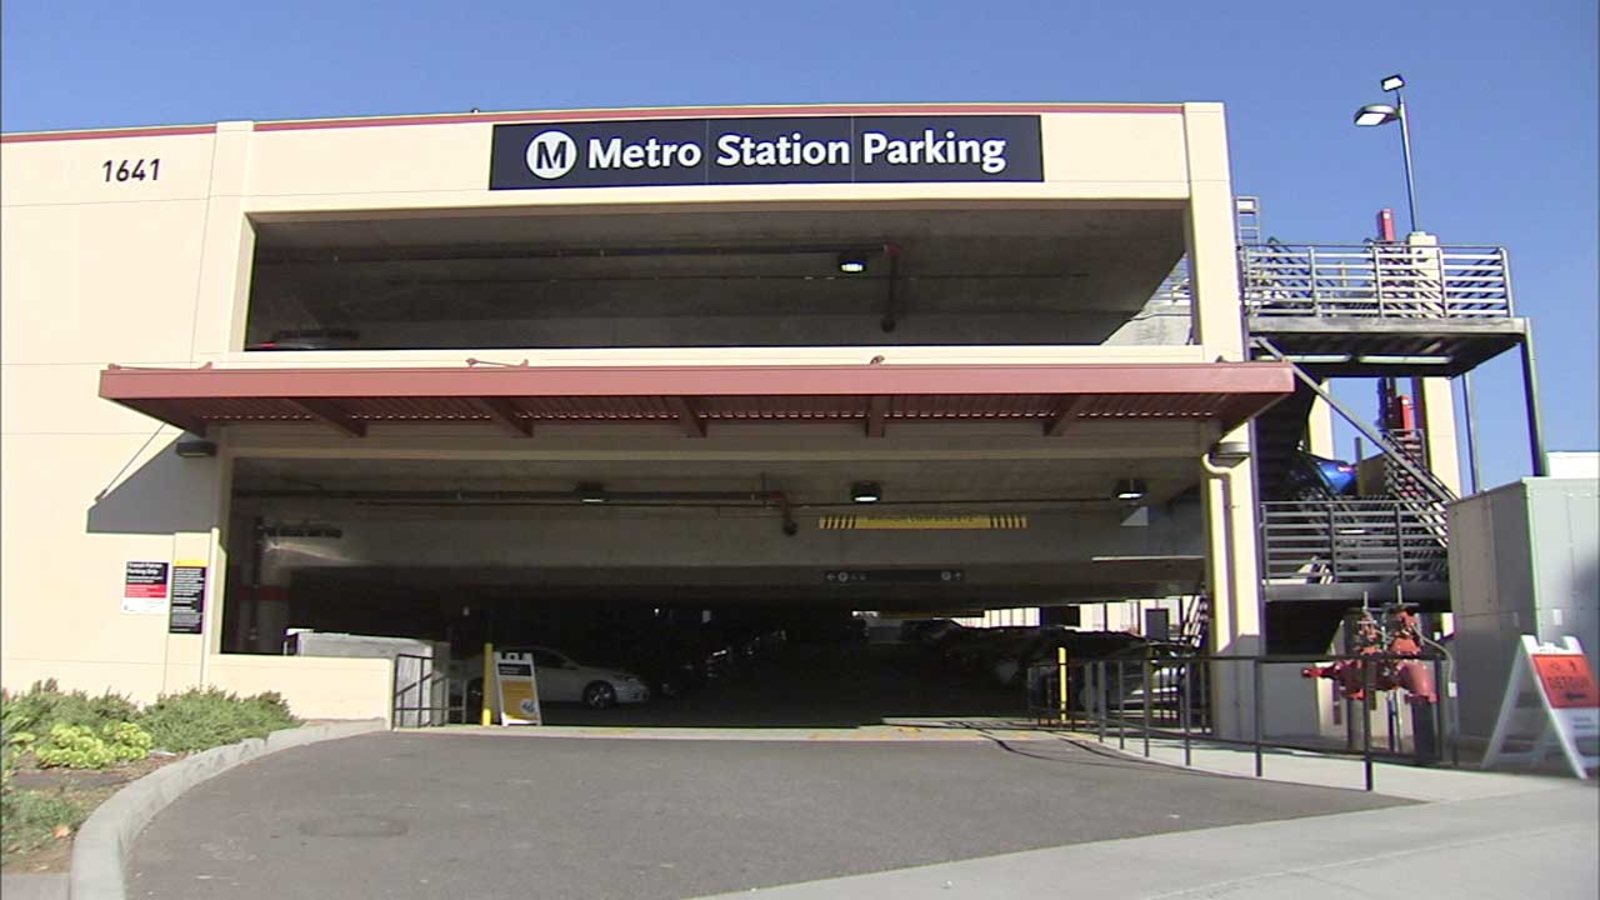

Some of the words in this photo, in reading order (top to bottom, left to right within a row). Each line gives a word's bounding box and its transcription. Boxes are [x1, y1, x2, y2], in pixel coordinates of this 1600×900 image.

[588, 138, 702, 169] Metro
[716, 132, 850, 166] Station
[863, 129, 1006, 174] Parking
[102, 158, 160, 182] 1641
